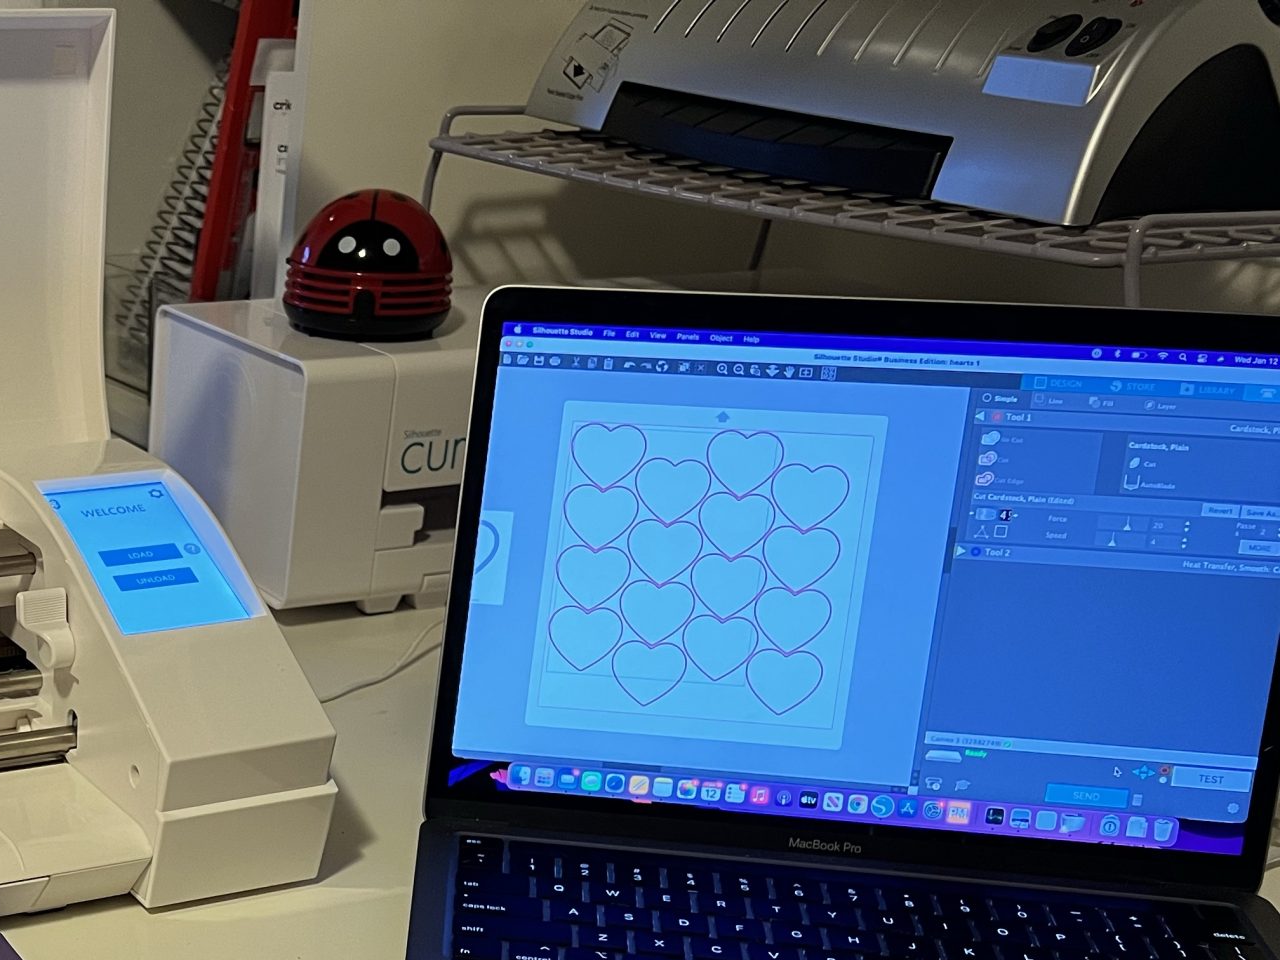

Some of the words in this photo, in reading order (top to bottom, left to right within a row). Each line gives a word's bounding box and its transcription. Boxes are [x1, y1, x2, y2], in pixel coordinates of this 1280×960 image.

[532, 326, 569, 336] Silhouette
[570, 328, 593, 337] Studio
[603, 329, 616, 337] File
[625, 330, 640, 339] Edit
[650, 331, 667, 340] View
[676, 332, 700, 341] Panels
[709, 334, 733, 343] Object
[743, 335, 760, 344] Help
[1235, 356, 1251, 364] Wed
[1252, 357, 1267, 365] Jan
[1050, 380, 1083, 389] DESIGN
[1126, 382, 1157, 391] STORE
[1006, 413, 1025, 421] Tool
[1170, 443, 1190, 452] Plain
[80, 503, 147, 519] WELCOME
[1246, 509, 1266, 517] Save
[1048, 515, 1068, 523] Force
[1045, 531, 1068, 540] Speed
[127, 549, 154, 560] LOAD
[985, 548, 1003, 556] Tool
[1183, 560, 1201, 569] Heat
[136, 573, 176, 586] UNLOAD
[1197, 774, 1225, 785] TEST
[704, 788, 717, 799] 12
[1072, 790, 1100, 801] SEND
[949, 807, 968, 819] PM
[788, 837, 841, 852] MacBook
[843, 842, 862, 854] Pro
[461, 925, 484, 933] shift
[1213, 932, 1246, 940] delete
